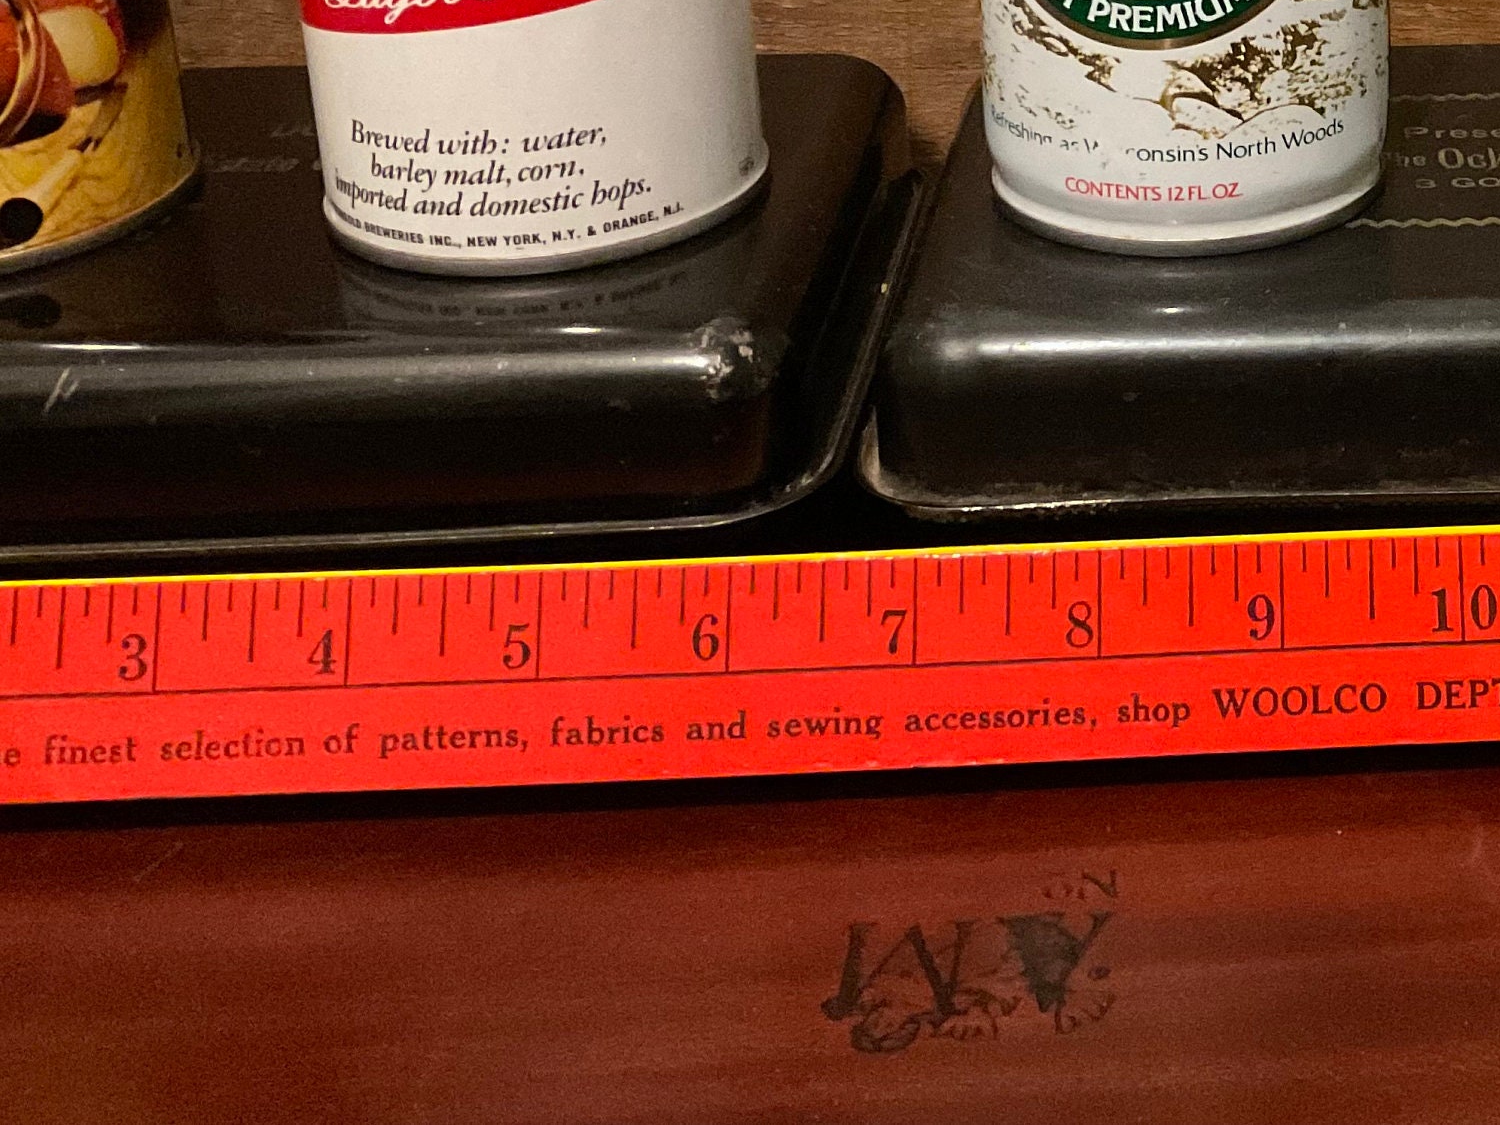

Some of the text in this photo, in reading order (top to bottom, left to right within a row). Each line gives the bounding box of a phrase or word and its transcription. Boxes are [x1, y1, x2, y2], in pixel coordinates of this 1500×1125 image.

[351, 119, 607, 156] Brewed with: water,
[1216, 136, 1277, 160] North
[1281, 118, 1344, 150] Woods
[334, 167, 652, 217] imported and domestic hops.
[371, 153, 437, 192] barley
[444, 160, 512, 188] malt,
[1064, 176, 1162, 202] CONTENTS
[364, 220, 424, 244] BREWERIES
[467, 234, 497, 248] NEW
[503, 232, 546, 245] YORK,
[552, 227, 581, 242] N.Y.
[587, 224, 597, 237] &
[602, 210, 660, 234] ORANGE,
[118, 633, 149, 682] 3
[307, 629, 337, 675] 4
[502, 622, 532, 670] 5
[692, 613, 721, 662] 6
[880, 609, 907, 655] 7
[1065, 601, 1094, 648] 8
[1248, 594, 1276, 641] 9
[1432, 584, 1498, 633] 10
[45, 734, 137, 765] finest
[160, 729, 305, 763] selection
[322, 722, 360, 754] of
[378, 722, 529, 759] patterns,
[549, 716, 666, 748] fabrics
[685, 710, 747, 741] and
[766, 710, 883, 741] sewing
[904, 699, 1098, 734] accessories,
[1116, 692, 1191, 729] shop
[1211, 682, 1387, 719] WOOLCO
